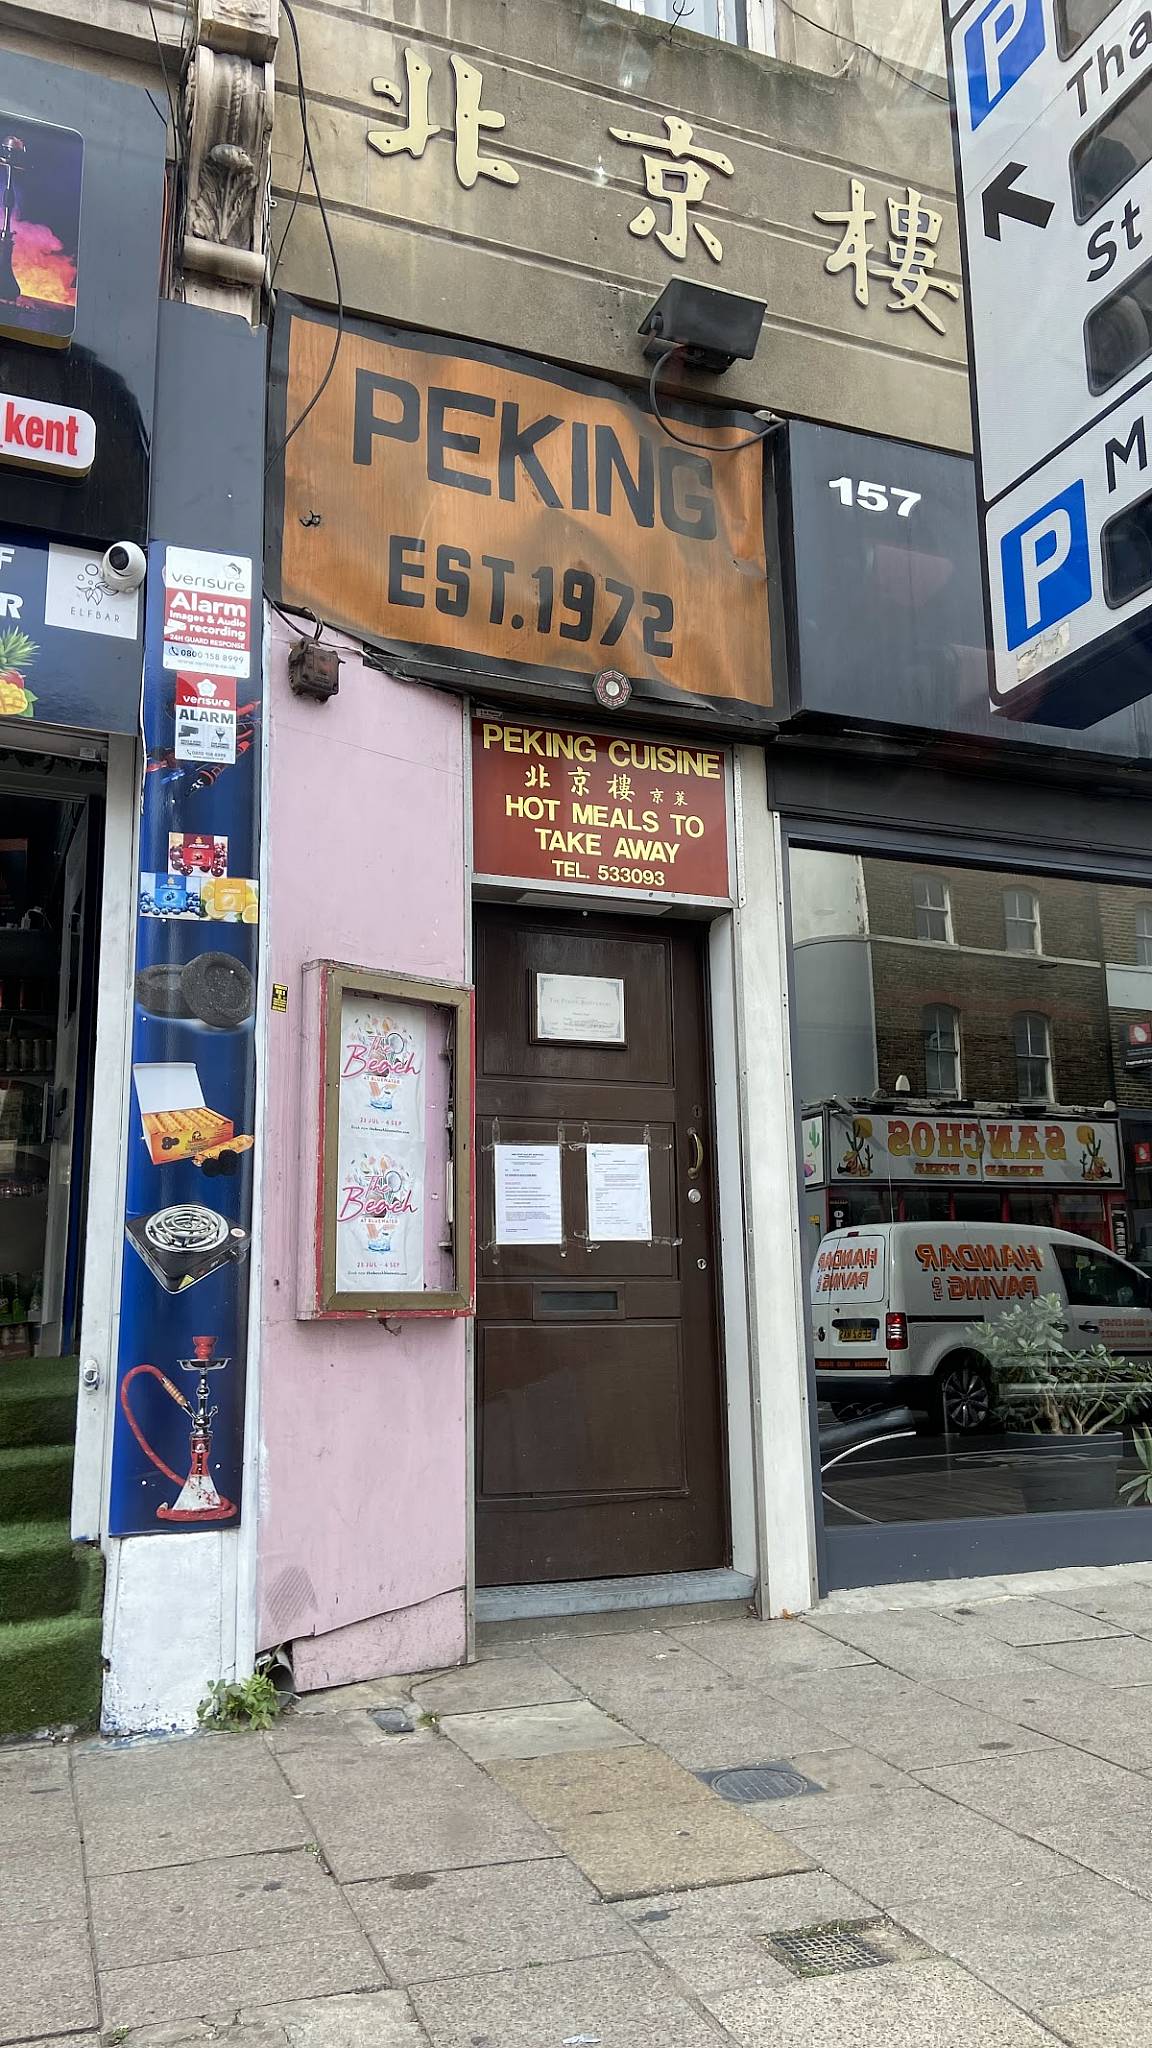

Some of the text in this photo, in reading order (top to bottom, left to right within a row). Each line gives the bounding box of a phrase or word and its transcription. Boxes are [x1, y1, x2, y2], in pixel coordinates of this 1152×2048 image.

[981, 0, 1028, 104] P
[366, 47, 959, 335] 北京樓
[1085, 198, 1143, 283] St
[353, 368, 717, 540] PEKING
[1104, 415, 1147, 494] M
[828, 476, 922, 518] 157
[172, 571, 246, 593] verisure
[1020, 508, 1071, 630] P
[70, 606, 121, 624] ELFBAR
[169, 609, 246, 628] Images & Audio
[170, 591, 246, 618] Alarm
[184, 636, 209, 646] GUARD
[210, 639, 246, 650] RESPONSE
[190, 624, 246, 640] recording
[180, 649, 245, 664] 0800 158 8999
[182, 694, 231, 708] verisure
[179, 708, 234, 725] ALARM
[483, 723, 721, 779] PEKING CUISINE
[524, 763, 636, 803] 北京樓
[505, 794, 705, 838] HOT MEALS TO
[534, 828, 681, 864] TAKE AWAY
[552, 859, 666, 887] TEL. 533093
[367, 1035, 391, 1056] The
[341, 1052, 421, 1079] Beach
[365, 1175, 391, 1198] The
[336, 1189, 419, 1223] Beach
